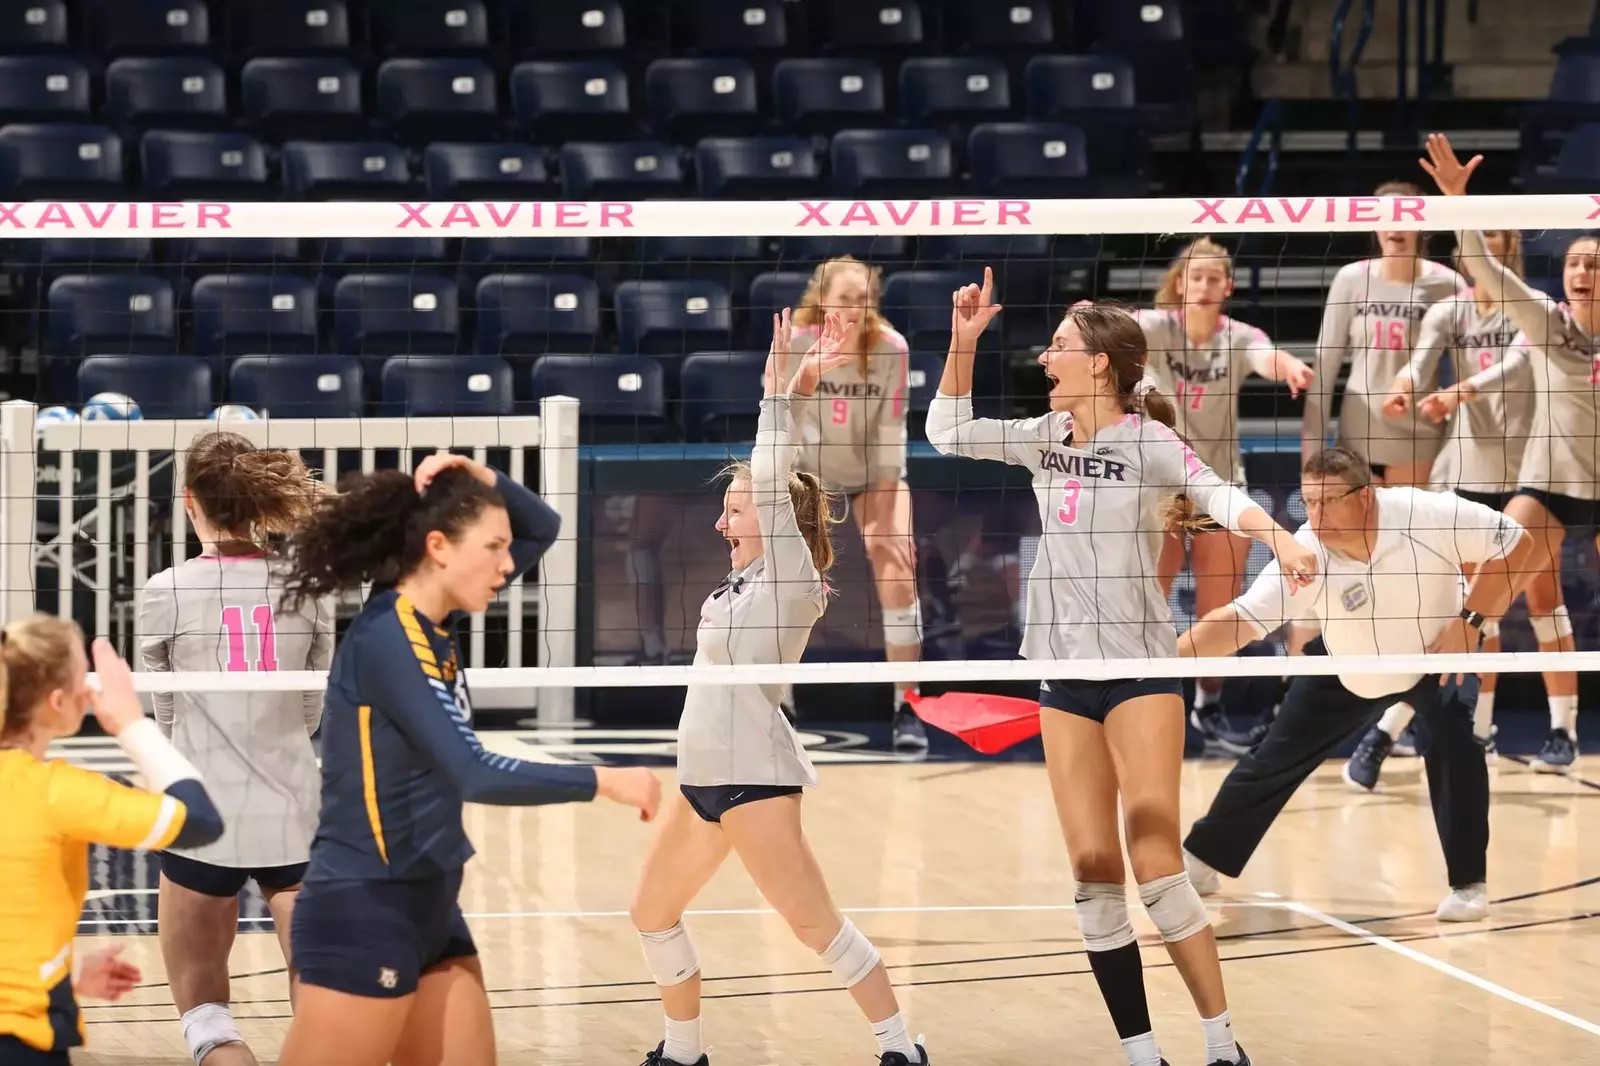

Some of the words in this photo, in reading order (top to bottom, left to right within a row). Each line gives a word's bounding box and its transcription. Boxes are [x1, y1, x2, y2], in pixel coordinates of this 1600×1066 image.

[0, 203, 232, 228] XAVIER
[395, 202, 635, 228] XAVIER
[795, 200, 1032, 227] XAVIER
[1190, 197, 1427, 224] XAVIER
[1374, 320, 1405, 351] 16
[815, 381, 881, 397] AVIER
[831, 399, 850, 426] 9
[1038, 449, 1125, 482] XAVIER
[1056, 477, 1083, 527] 3
[220, 604, 279, 673] 11
